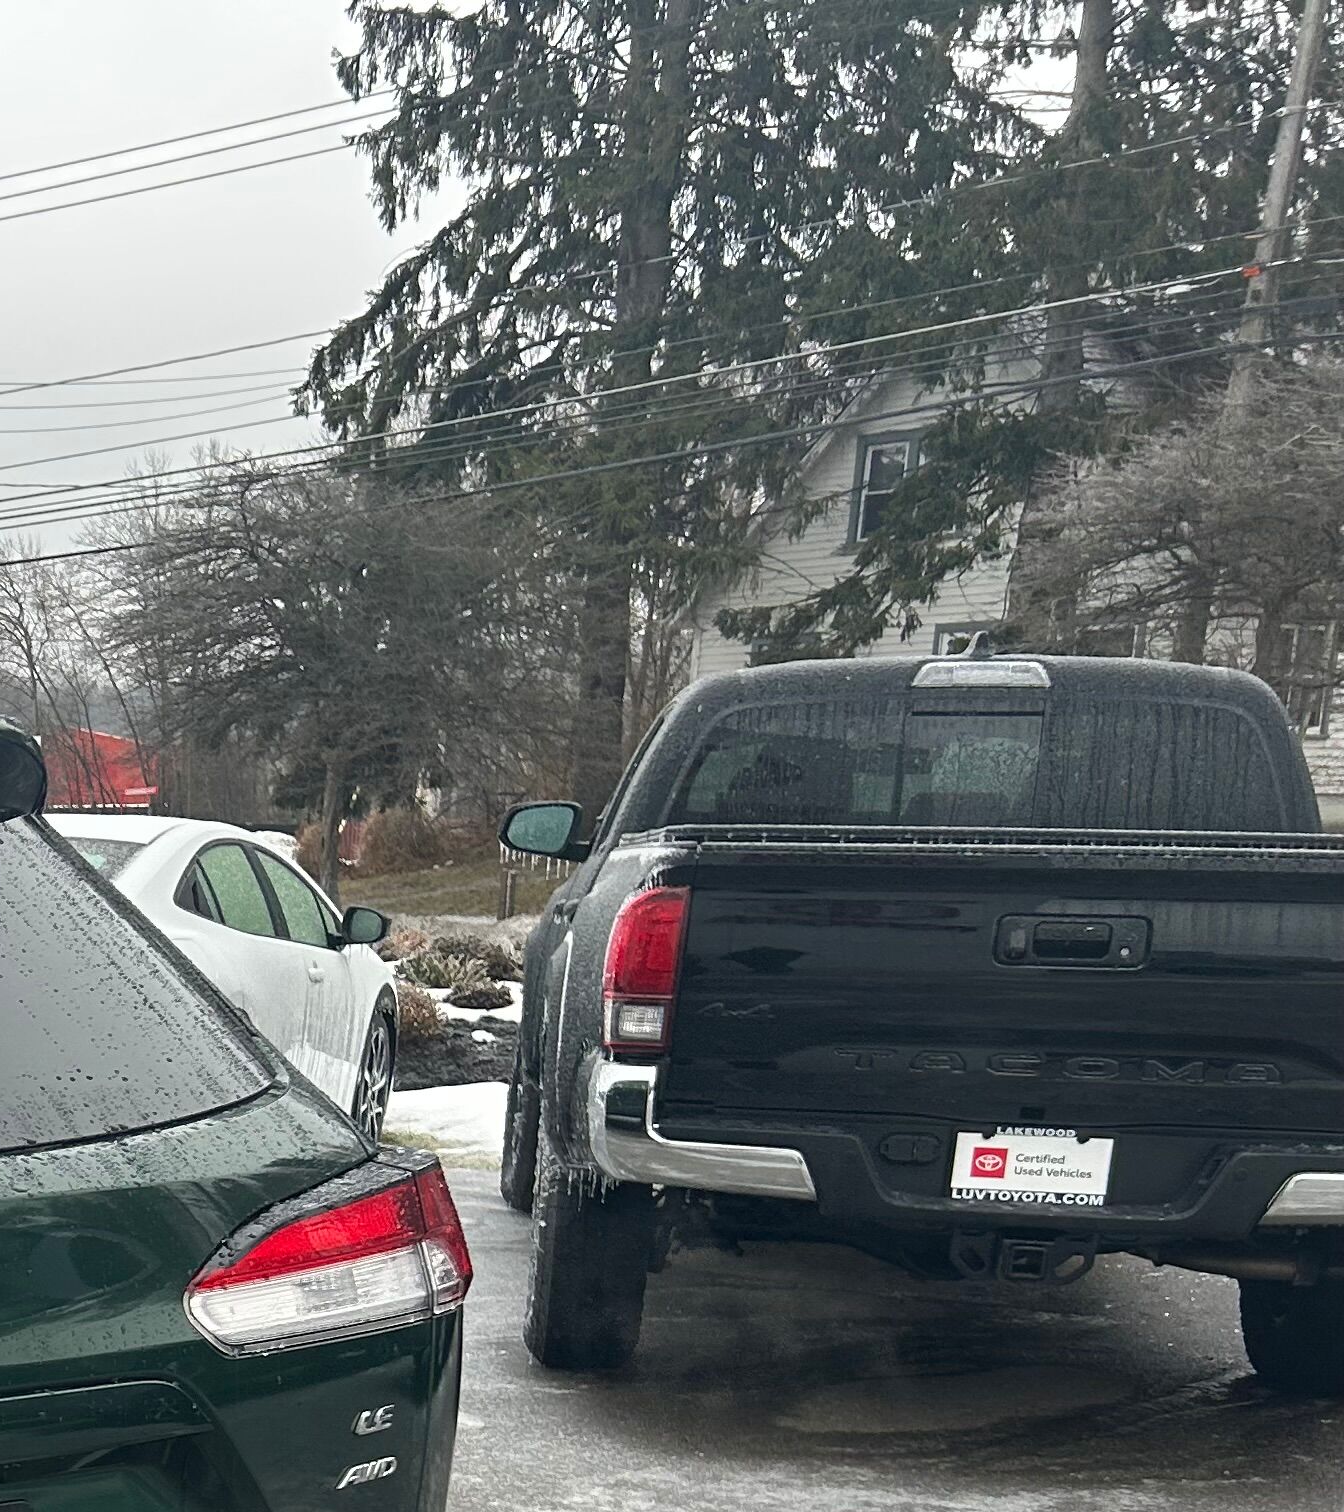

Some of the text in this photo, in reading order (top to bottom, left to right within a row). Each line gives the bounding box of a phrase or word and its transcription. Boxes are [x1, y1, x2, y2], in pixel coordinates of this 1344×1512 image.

[834, 1048, 1285, 1086] TACOMA
[996, 1126, 1077, 1138] LAKEWOOD
[1015, 1153, 1066, 1164] Certified
[1014, 1166, 1092, 1179] Used Vehicles
[951, 1188, 1104, 1206] LUVTOYOTA.COM
[354, 1404, 395, 1436] LE
